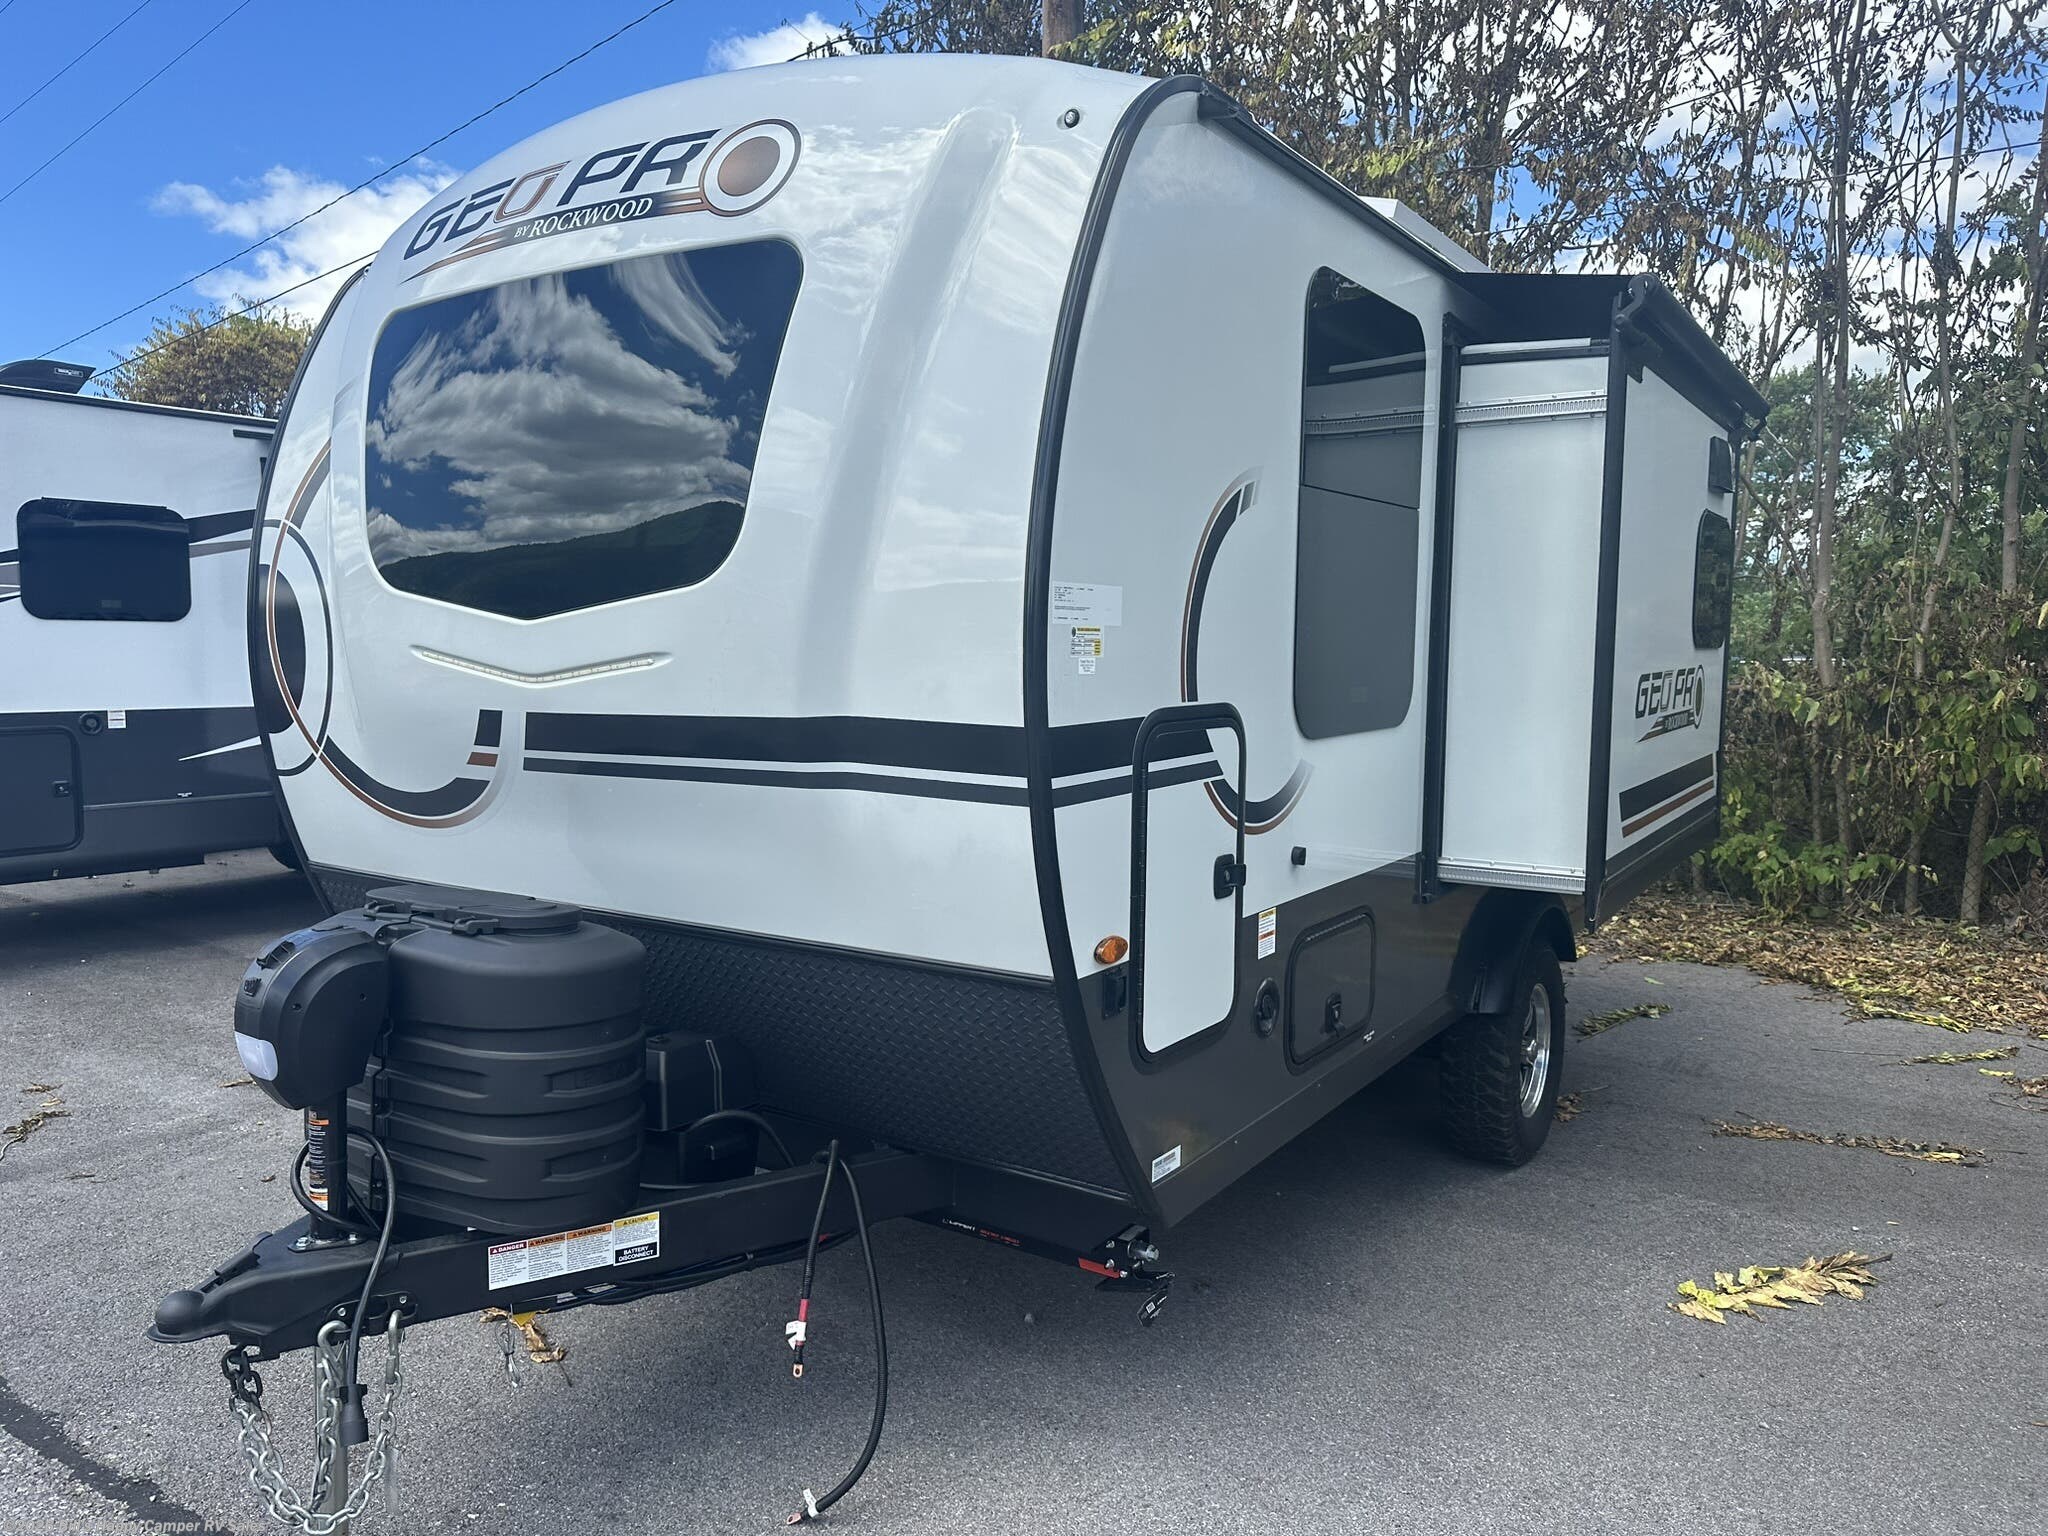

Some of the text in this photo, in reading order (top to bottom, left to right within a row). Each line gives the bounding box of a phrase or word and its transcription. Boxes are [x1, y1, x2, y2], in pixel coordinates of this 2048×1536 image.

[403, 160, 571, 260] GEO
[514, 197, 653, 238] BY ROCKWOOD
[1635, 670, 1674, 719] GEO
[498, 1242, 525, 1253] DANGER
[618, 1249, 654, 1262] DISCONNECT
[623, 1245, 649, 1256] BATTERY
